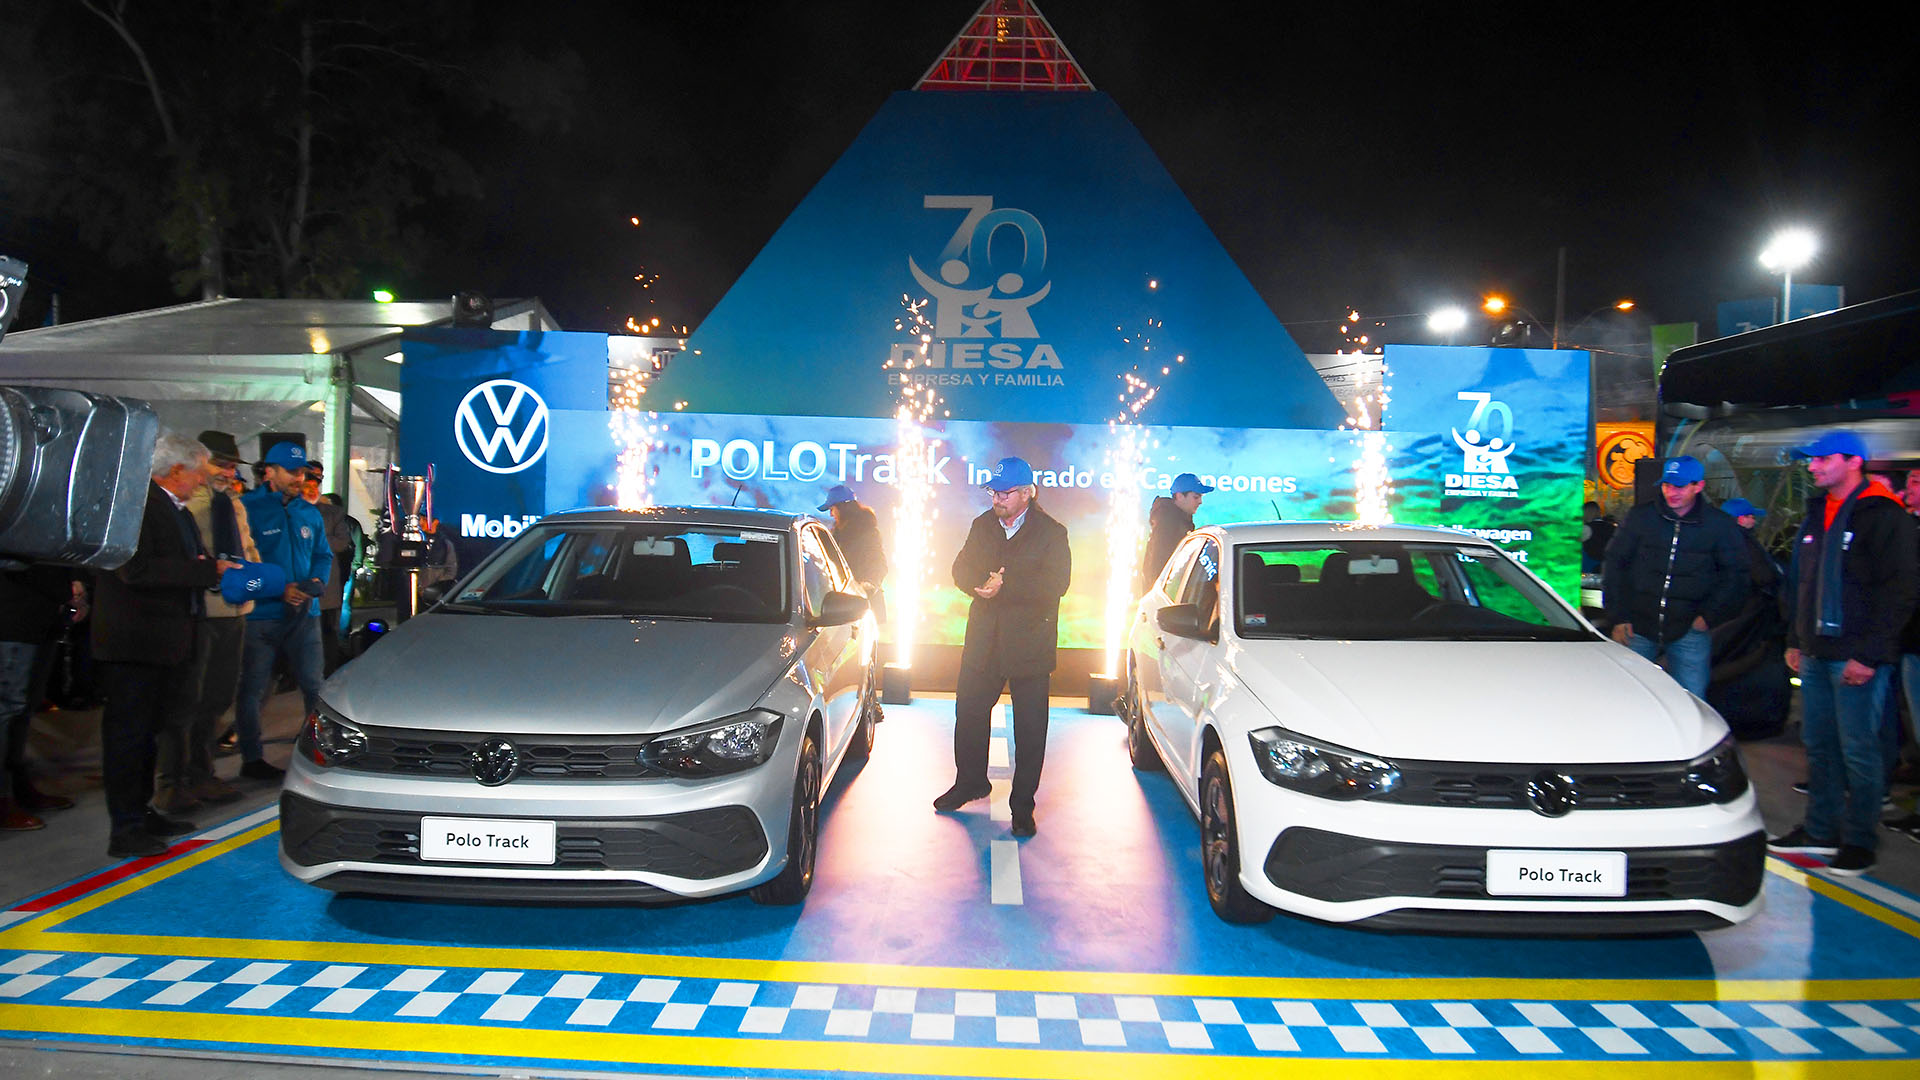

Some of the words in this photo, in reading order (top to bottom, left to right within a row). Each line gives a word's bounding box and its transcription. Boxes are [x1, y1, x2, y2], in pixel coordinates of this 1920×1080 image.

[924, 195, 1047, 275] 70
[889, 343, 1065, 369] DIESA
[888, 374, 974, 385] EPRESA
[978, 374, 990, 386] Y
[995, 374, 1065, 386] FAMILIA
[1457, 391, 1513, 441] 70
[829, 443, 951, 485] Trak
[1142, 467, 1297, 493] Capeones
[1445, 474, 1519, 489] DIESA
[446, 832, 481, 847] Polo
[486, 834, 529, 848] Track
[1519, 867, 1554, 881] Polo
[1559, 868, 1602, 883] Track
